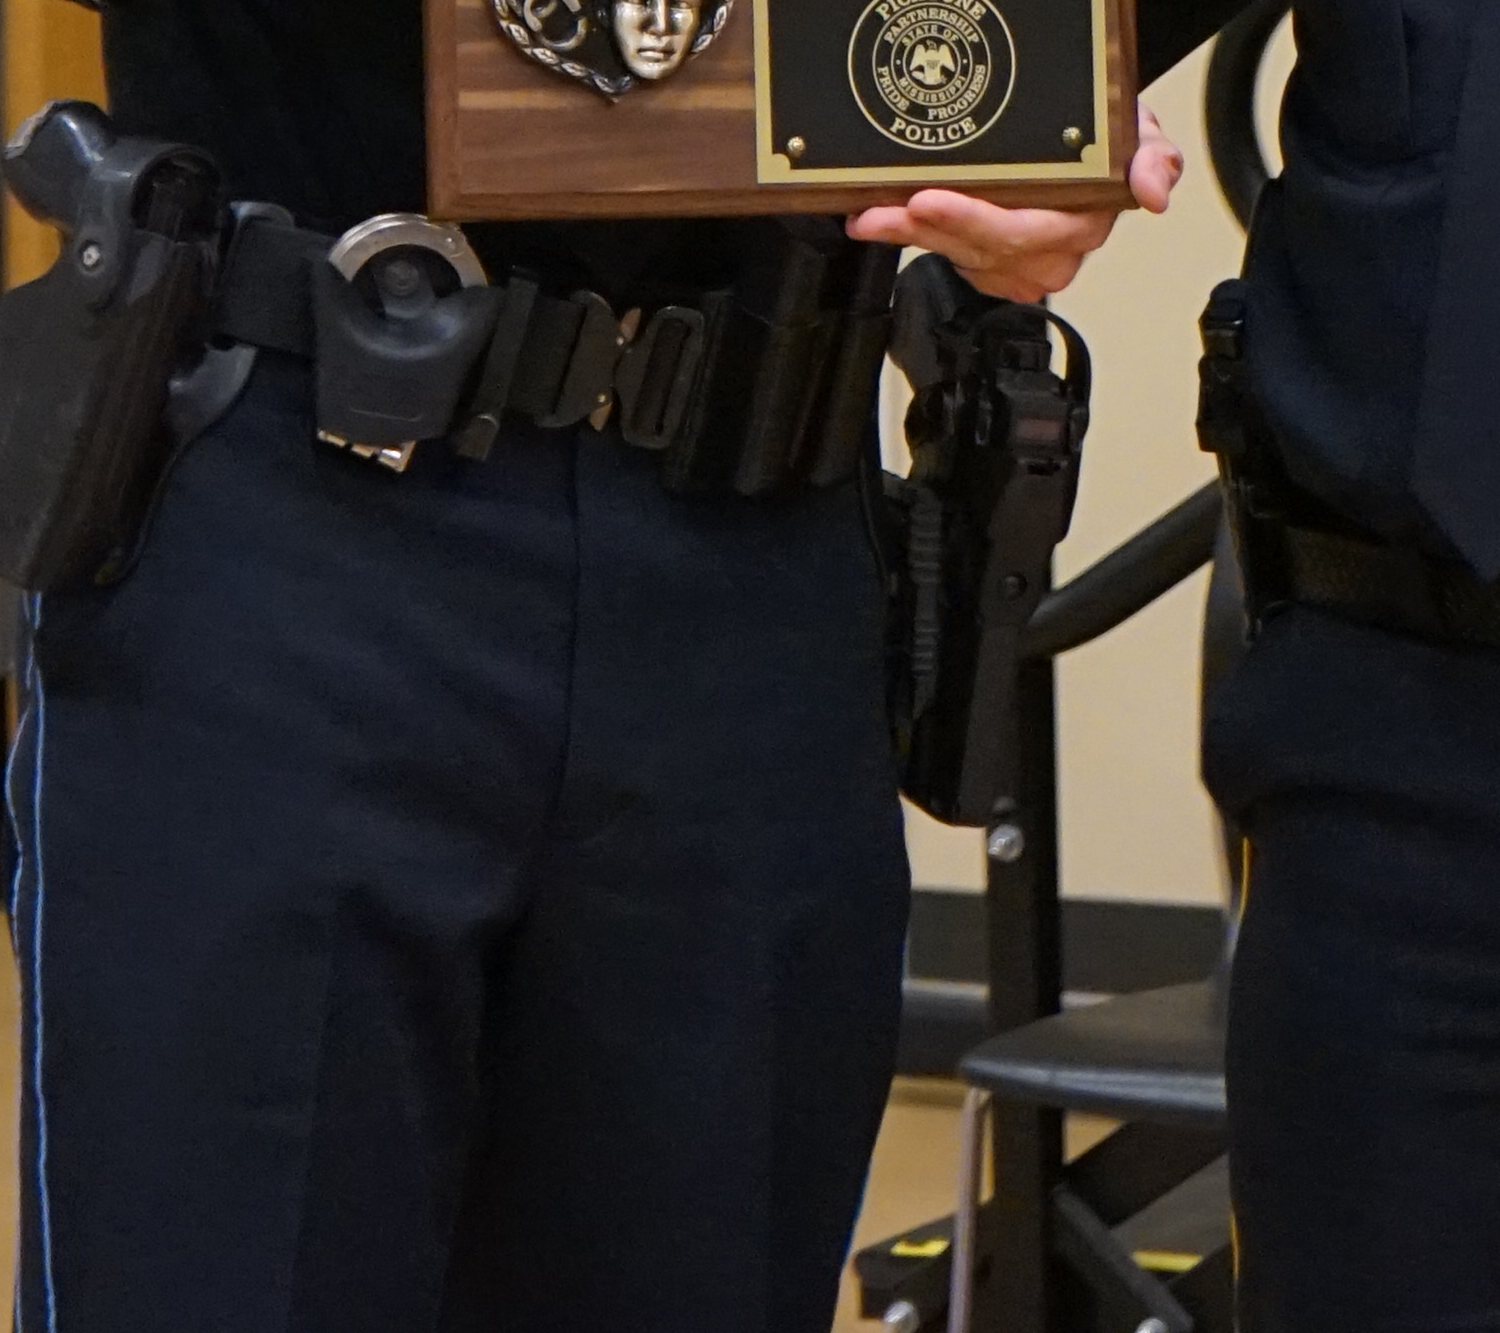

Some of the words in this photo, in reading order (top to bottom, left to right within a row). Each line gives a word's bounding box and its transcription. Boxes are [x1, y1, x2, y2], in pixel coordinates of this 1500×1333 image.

[884, 7, 980, 45] PARTNERSHIP
[901, 24, 938, 47] STATE
[943, 27, 960, 43] OF
[877, 66, 910, 112] PRIDE
[899, 75, 966, 103] MISSISSIPPI
[927, 64, 987, 120] PROGRESS
[890, 116, 977, 143] POLICE
